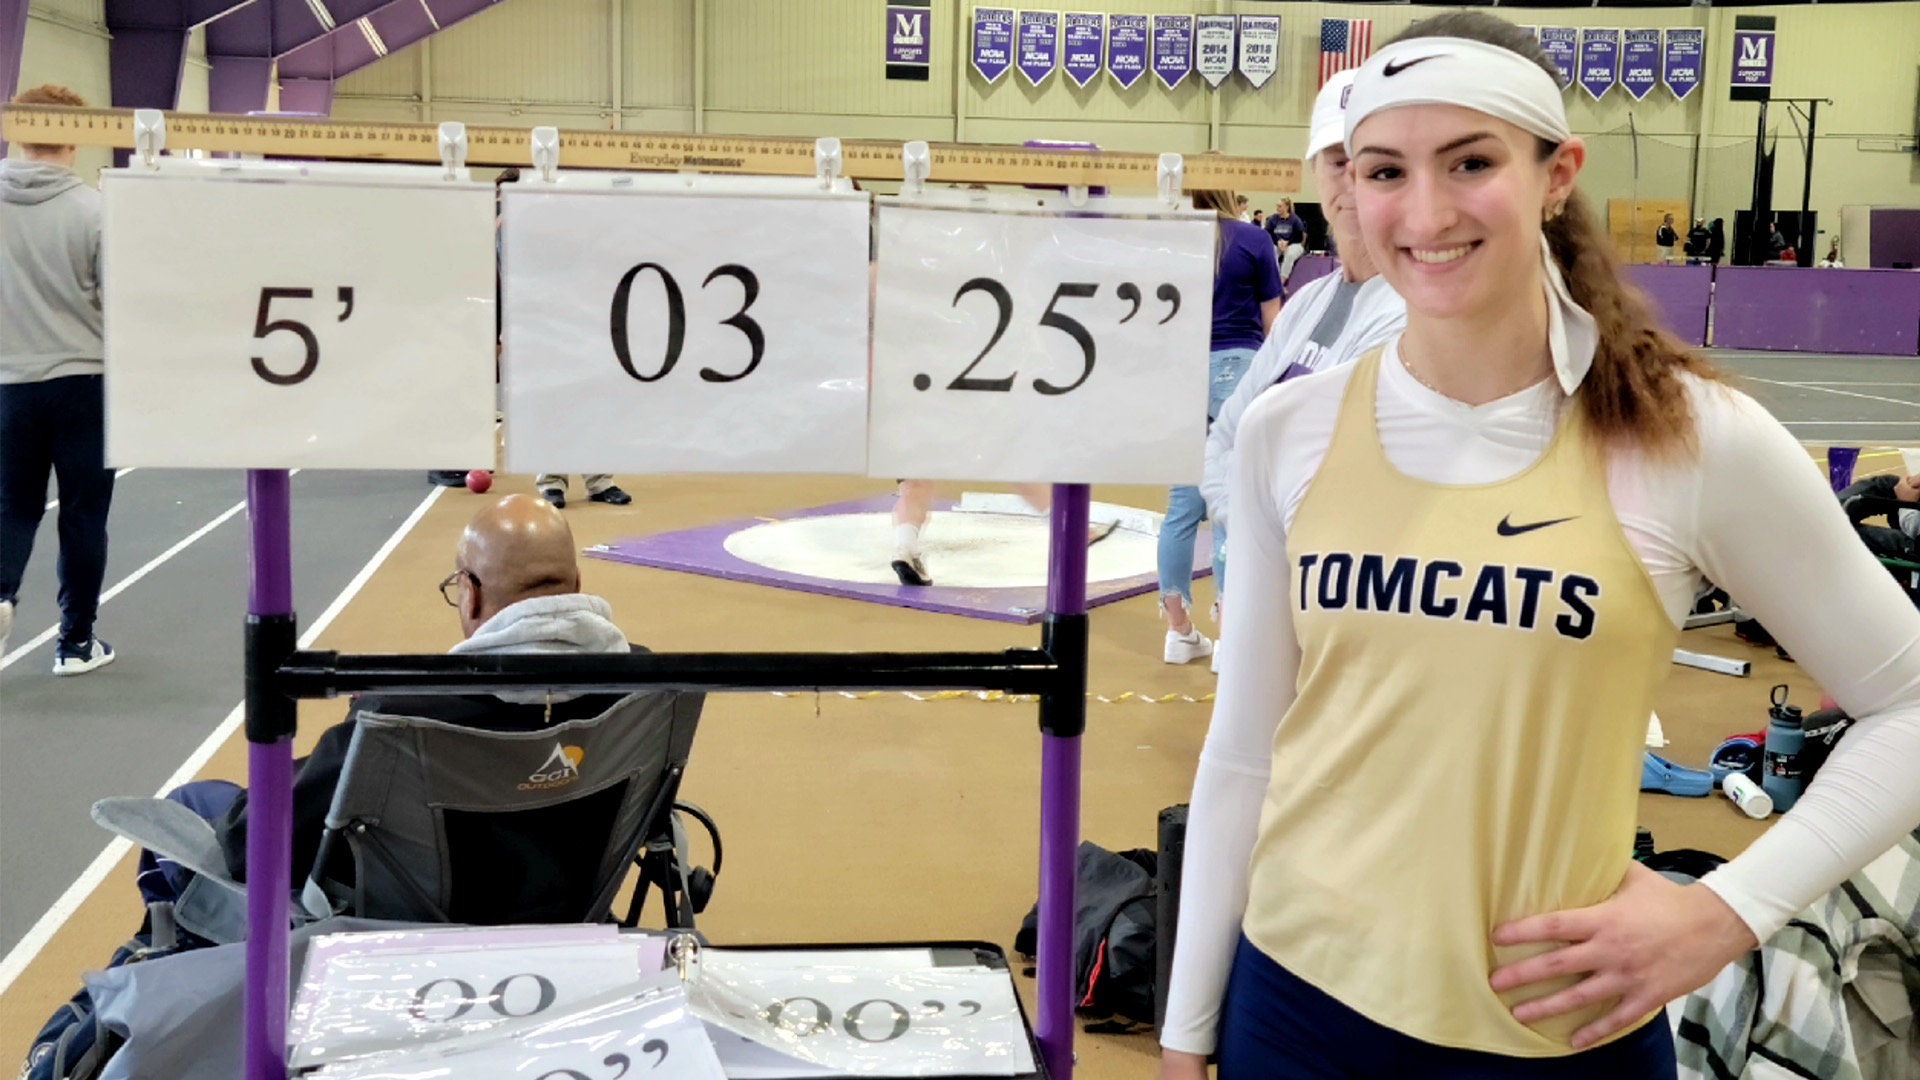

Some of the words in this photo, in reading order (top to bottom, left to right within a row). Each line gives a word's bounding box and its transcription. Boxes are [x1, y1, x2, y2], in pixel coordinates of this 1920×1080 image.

[896, 14, 922, 36] M
[1203, 45, 1227, 54] 2014
[1742, 37, 1767, 60] M
[1204, 56, 1226, 64] NCAA
[630, 152, 682, 167] Everyday
[611, 263, 764, 383] 03
[1298, 552, 1600, 641] TOMCATS
[408, 972, 556, 1023] 00
